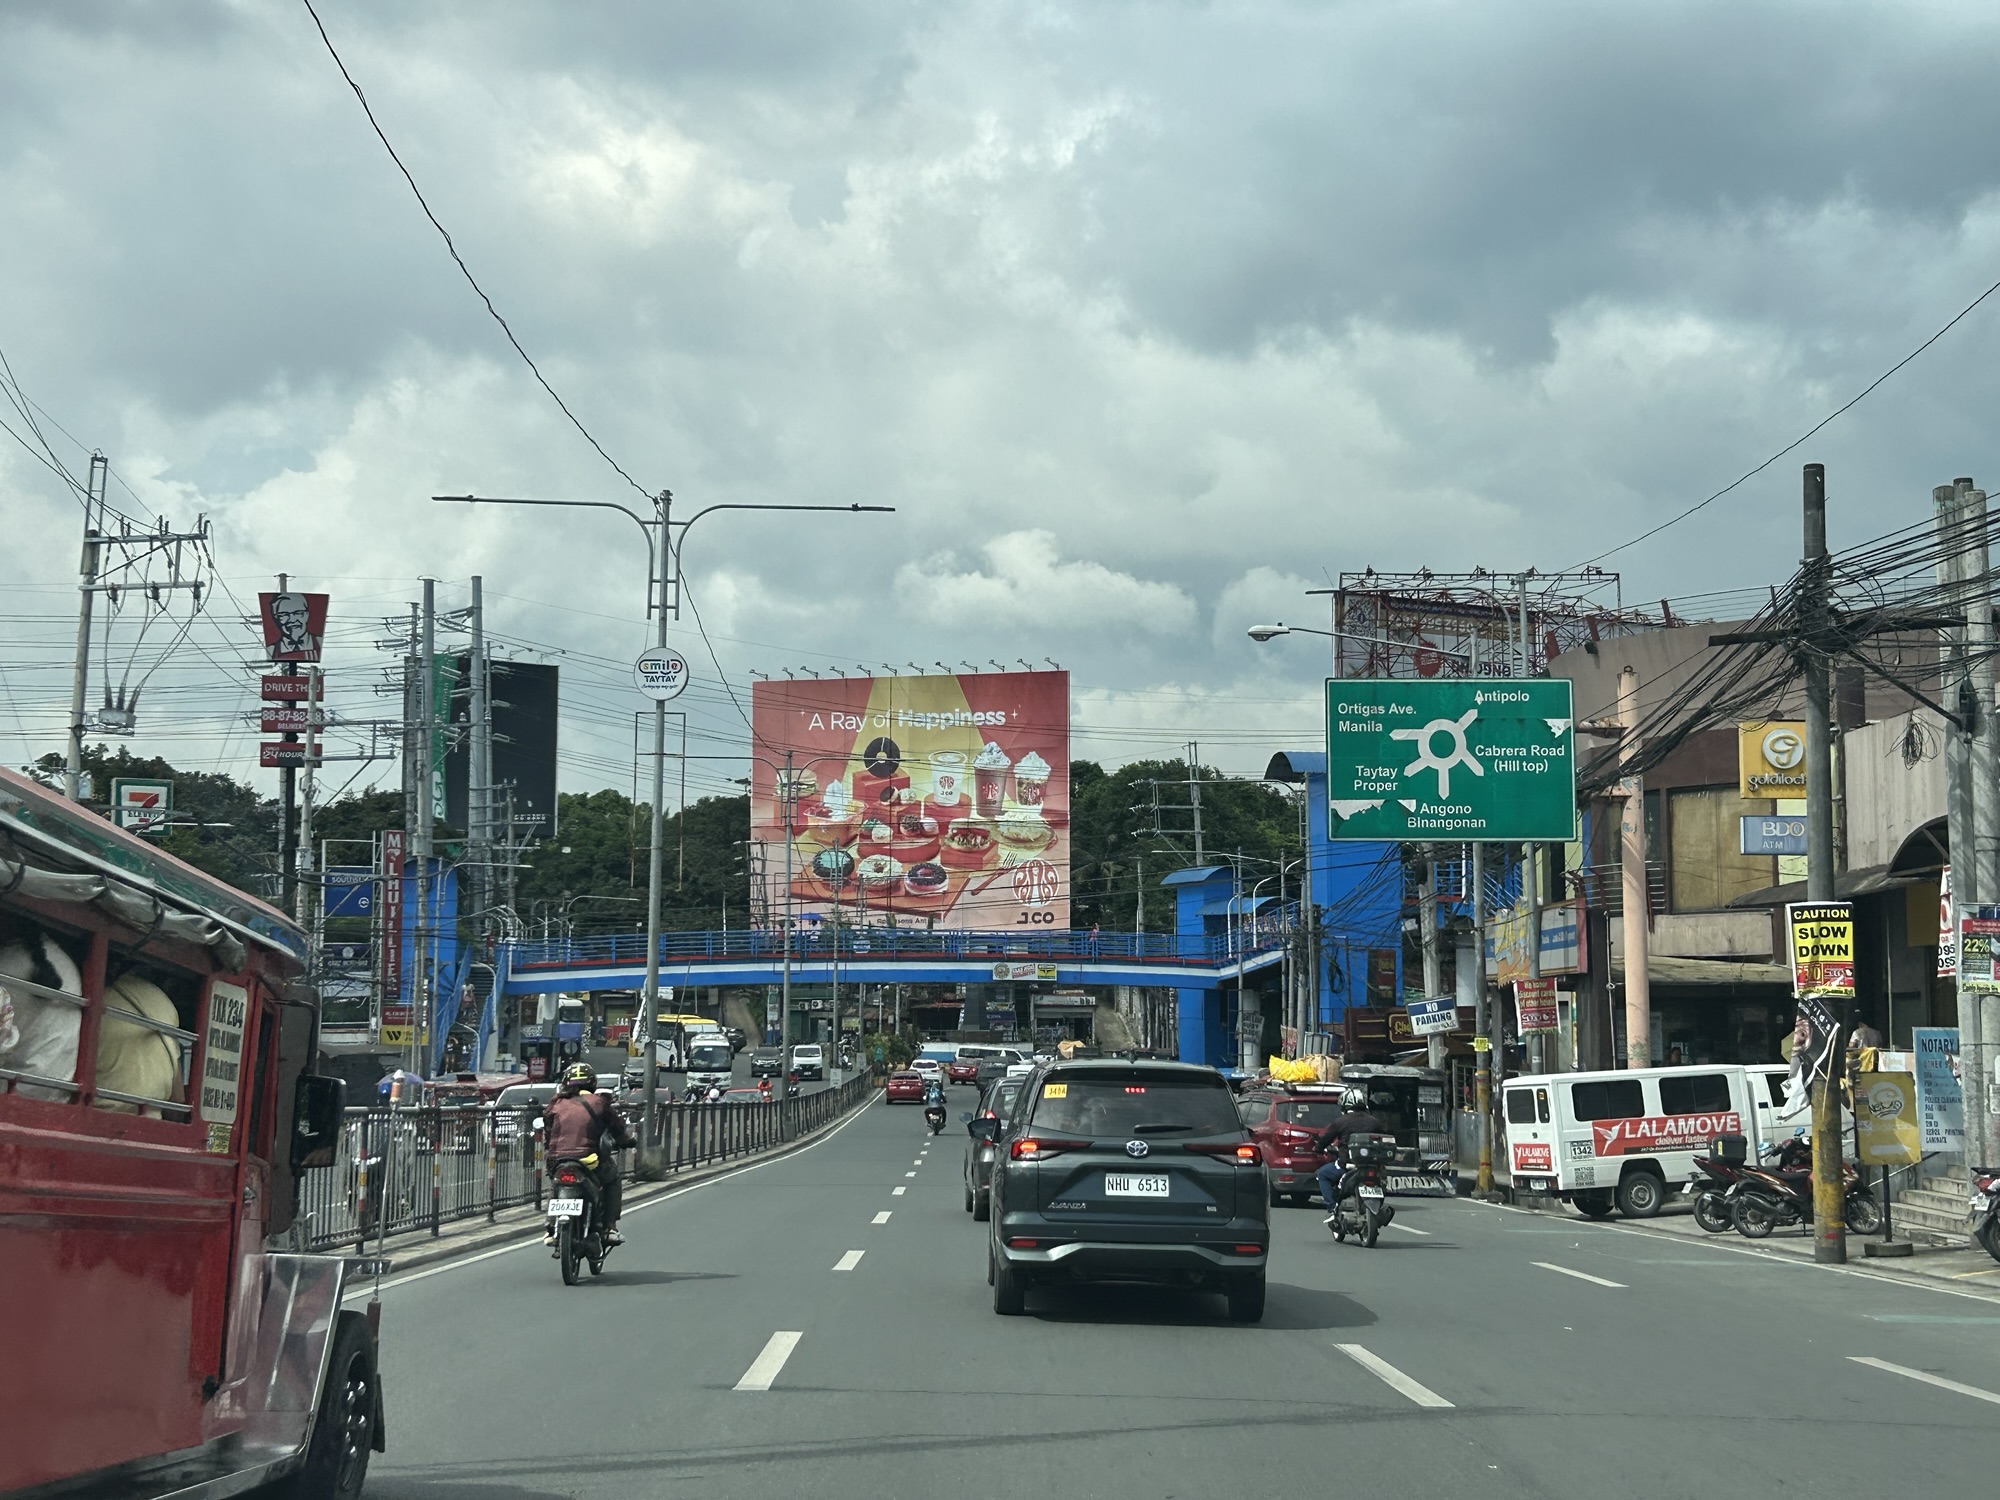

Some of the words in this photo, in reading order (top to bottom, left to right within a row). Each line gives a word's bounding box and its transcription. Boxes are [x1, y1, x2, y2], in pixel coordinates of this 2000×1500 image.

[643, 660, 678, 670] smile
[264, 683, 293, 692] DRIVE
[1474, 690, 1530, 703] Antipolo
[1338, 703, 1386, 716] Ortigas
[1388, 703, 1417, 715] Ave.
[808, 712, 825, 731] A
[830, 711, 868, 733] Ray
[873, 708, 891, 728] of
[898, 708, 1006, 731] Happiness
[1338, 721, 1383, 732] Manila
[1475, 745, 1527, 757] Cabrera
[1530, 745, 1565, 757] Road
[1355, 765, 1398, 779] Taytay
[1494, 759, 1520, 773] (Hill
[1522, 759, 1548, 773] top)
[1353, 780, 1398, 792] Proper
[1420, 803, 1472, 815] Angono
[1407, 817, 1486, 829] Binangonan
[1762, 821, 1805, 837] BDO
[1762, 840, 1784, 850] ATM
[1793, 909, 1849, 920] CAUTION
[1798, 926, 1847, 940] SLOW
[1798, 944, 1849, 958] DOWN
[1963, 938, 1990, 953] 22%
[1425, 1002, 1438, 1013] NO
[1415, 1011, 1452, 1026] PARKING
[1921, 1038, 1954, 1053] NOTARY
[1923, 1059, 1942, 1069] OTHER
[1624, 1114, 1738, 1139] LALAMOVE
[1655, 1135, 1683, 1146] deliver
[1684, 1134, 1709, 1144] faster
[1572, 1147, 1592, 1155] 1342
[1107, 1178, 1130, 1191] NHU
[1138, 1178, 1168, 1192] 6513
[1048, 1202, 1087, 1210] AVANZA
